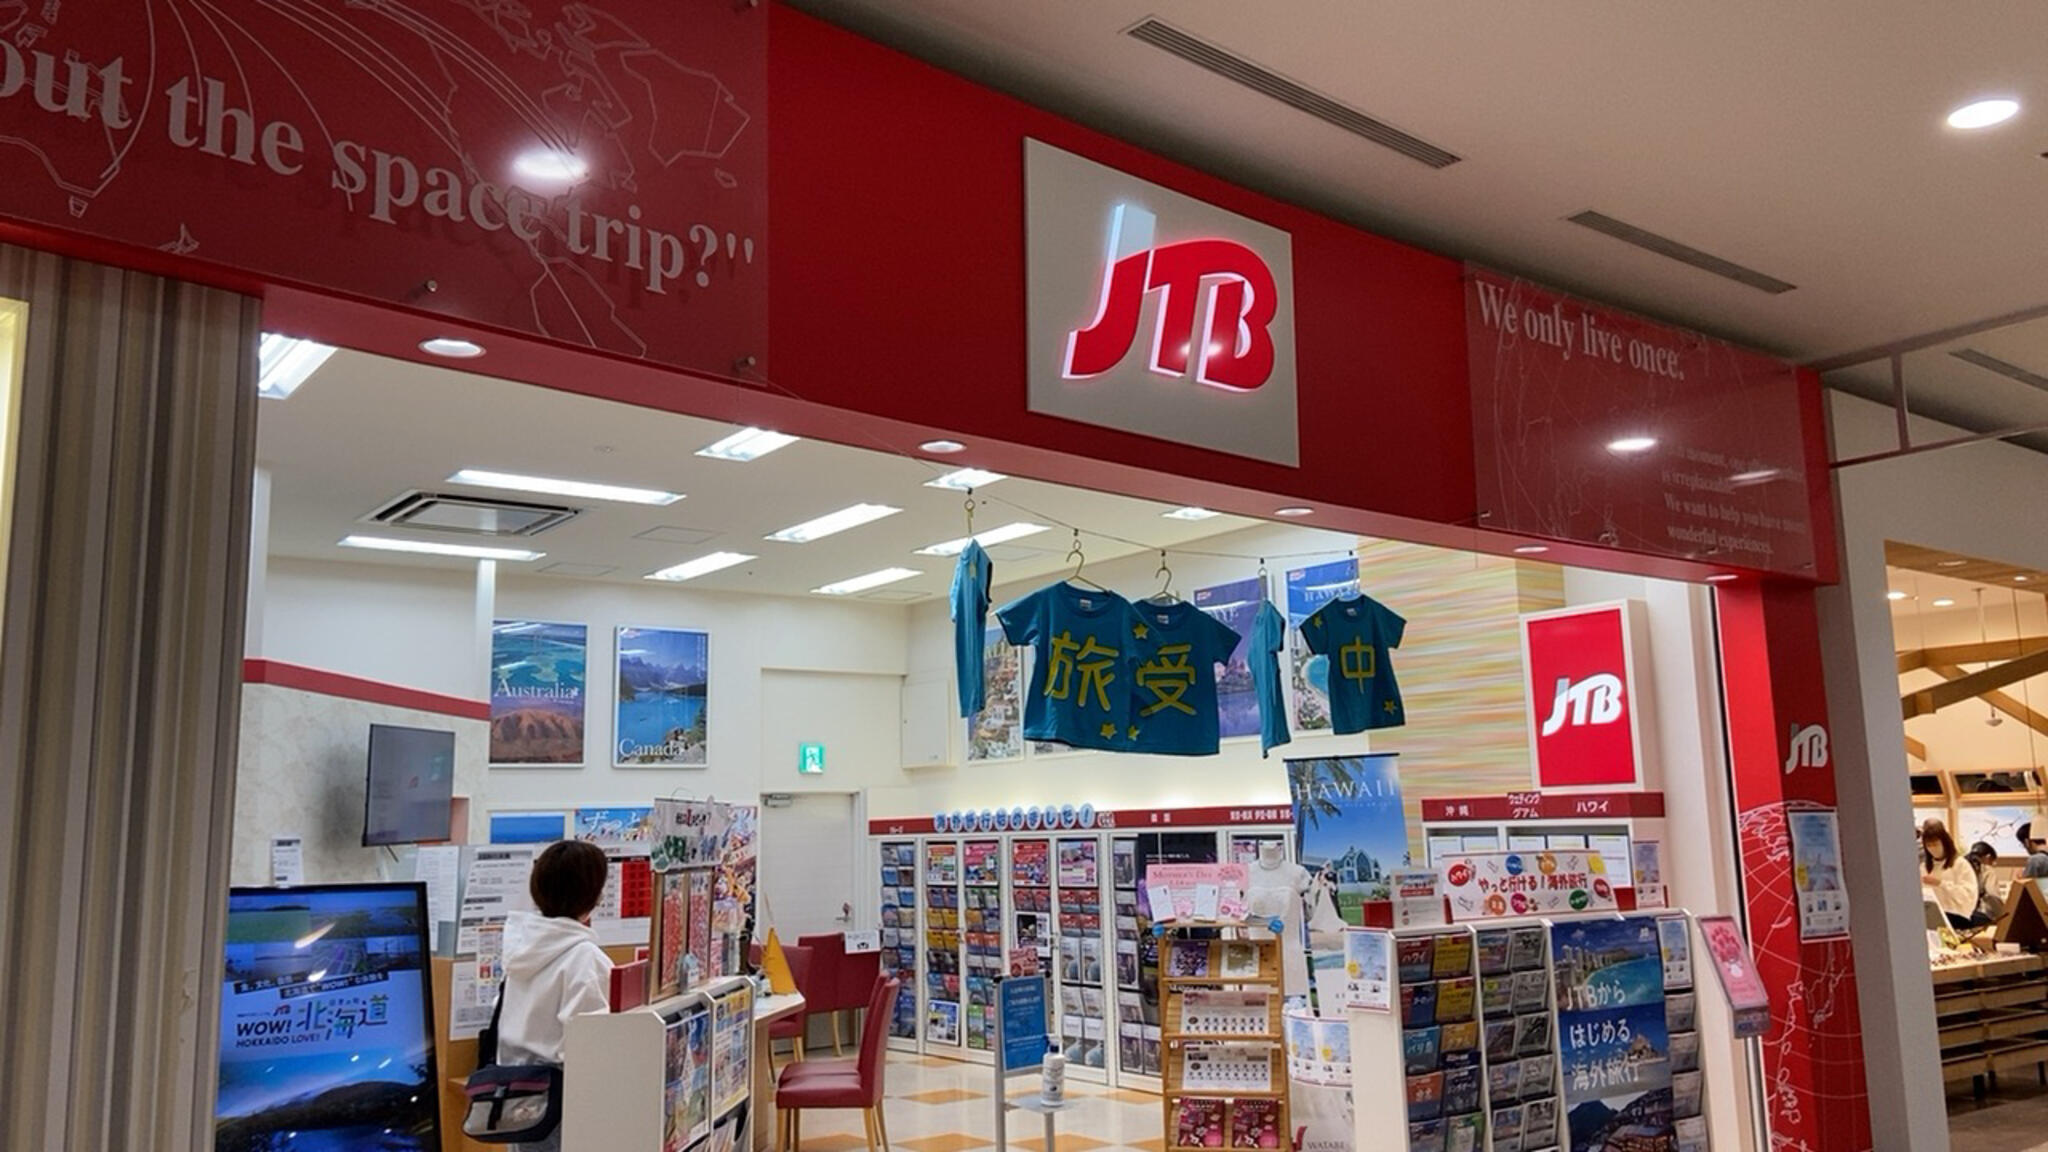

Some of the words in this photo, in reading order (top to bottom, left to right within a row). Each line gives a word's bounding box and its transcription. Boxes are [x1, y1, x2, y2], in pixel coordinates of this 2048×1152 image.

[165, 75, 304, 176] the
[332, 138, 543, 240] space
[1062, 204, 1277, 392] JTB
[1476, 280, 1518, 334] We
[1524, 303, 1575, 361] only
[1582, 311, 1622, 363] live
[1629, 338, 1684, 380] once.
[1045, 631, 1118, 711] 旅
[1137, 643, 1198, 716] 受
[1340, 636, 1376, 694] 中
[493, 677, 575, 699] Australia
[1542, 673, 1623, 737] JTB
[619, 738, 682, 757] Canada
[1785, 723, 1828, 775] JTB
[1295, 780, 1395, 801] HAWAII
[1576, 800, 1609, 813] ハワイ
[1512, 808, 1540, 819] グアム
[1567, 980, 1626, 1011] JTBから
[236, 1020, 292, 1037] WOW!
[297, 994, 389, 1041] 北海道
[1569, 1018, 1632, 1049] はじめる
[236, 1035, 289, 1049] HOKKAIDO
[1572, 1055, 1640, 1091] 海外旅行
